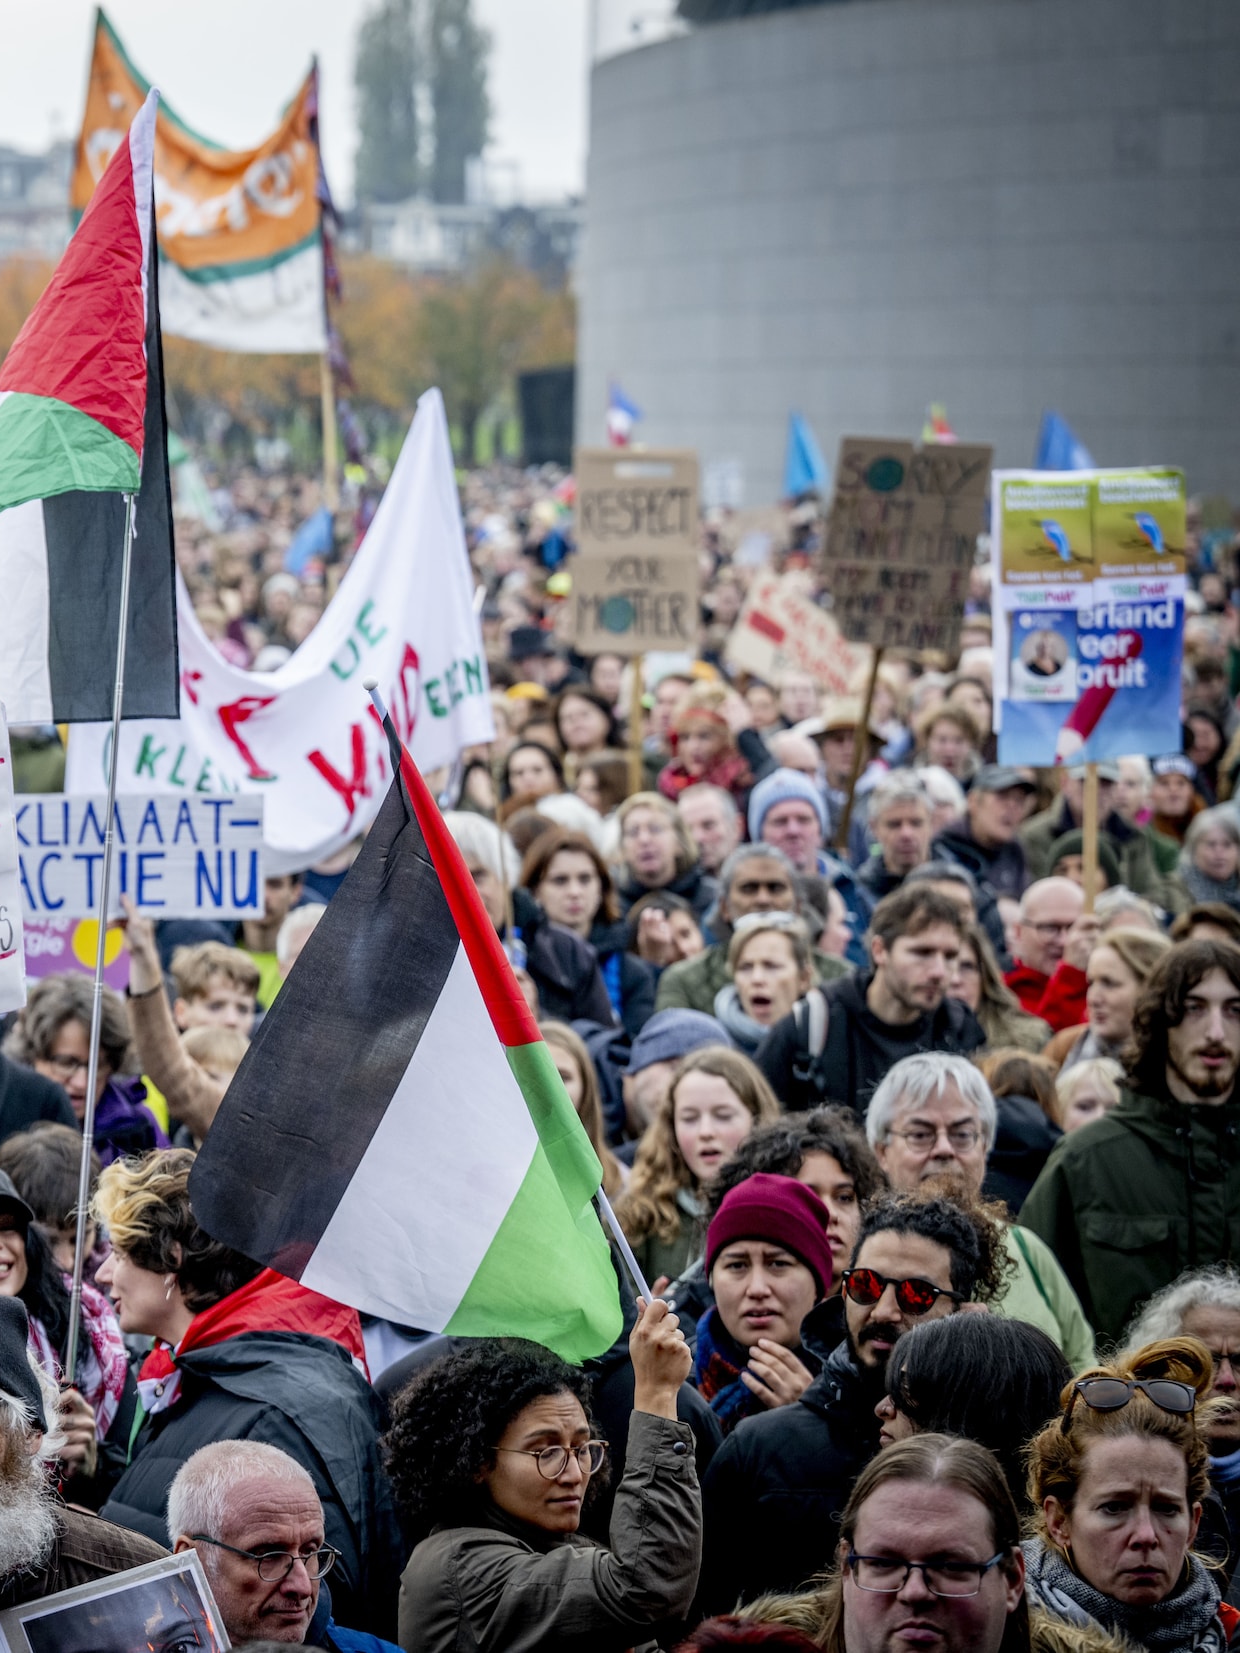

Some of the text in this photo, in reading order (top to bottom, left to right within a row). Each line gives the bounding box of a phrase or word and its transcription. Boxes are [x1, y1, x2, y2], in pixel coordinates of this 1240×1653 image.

[580, 487, 691, 541] RESPECT
[1077, 633, 1135, 659] eer
[16, 799, 260, 847] KLIMAAT-
[195, 849, 258, 909] NU
